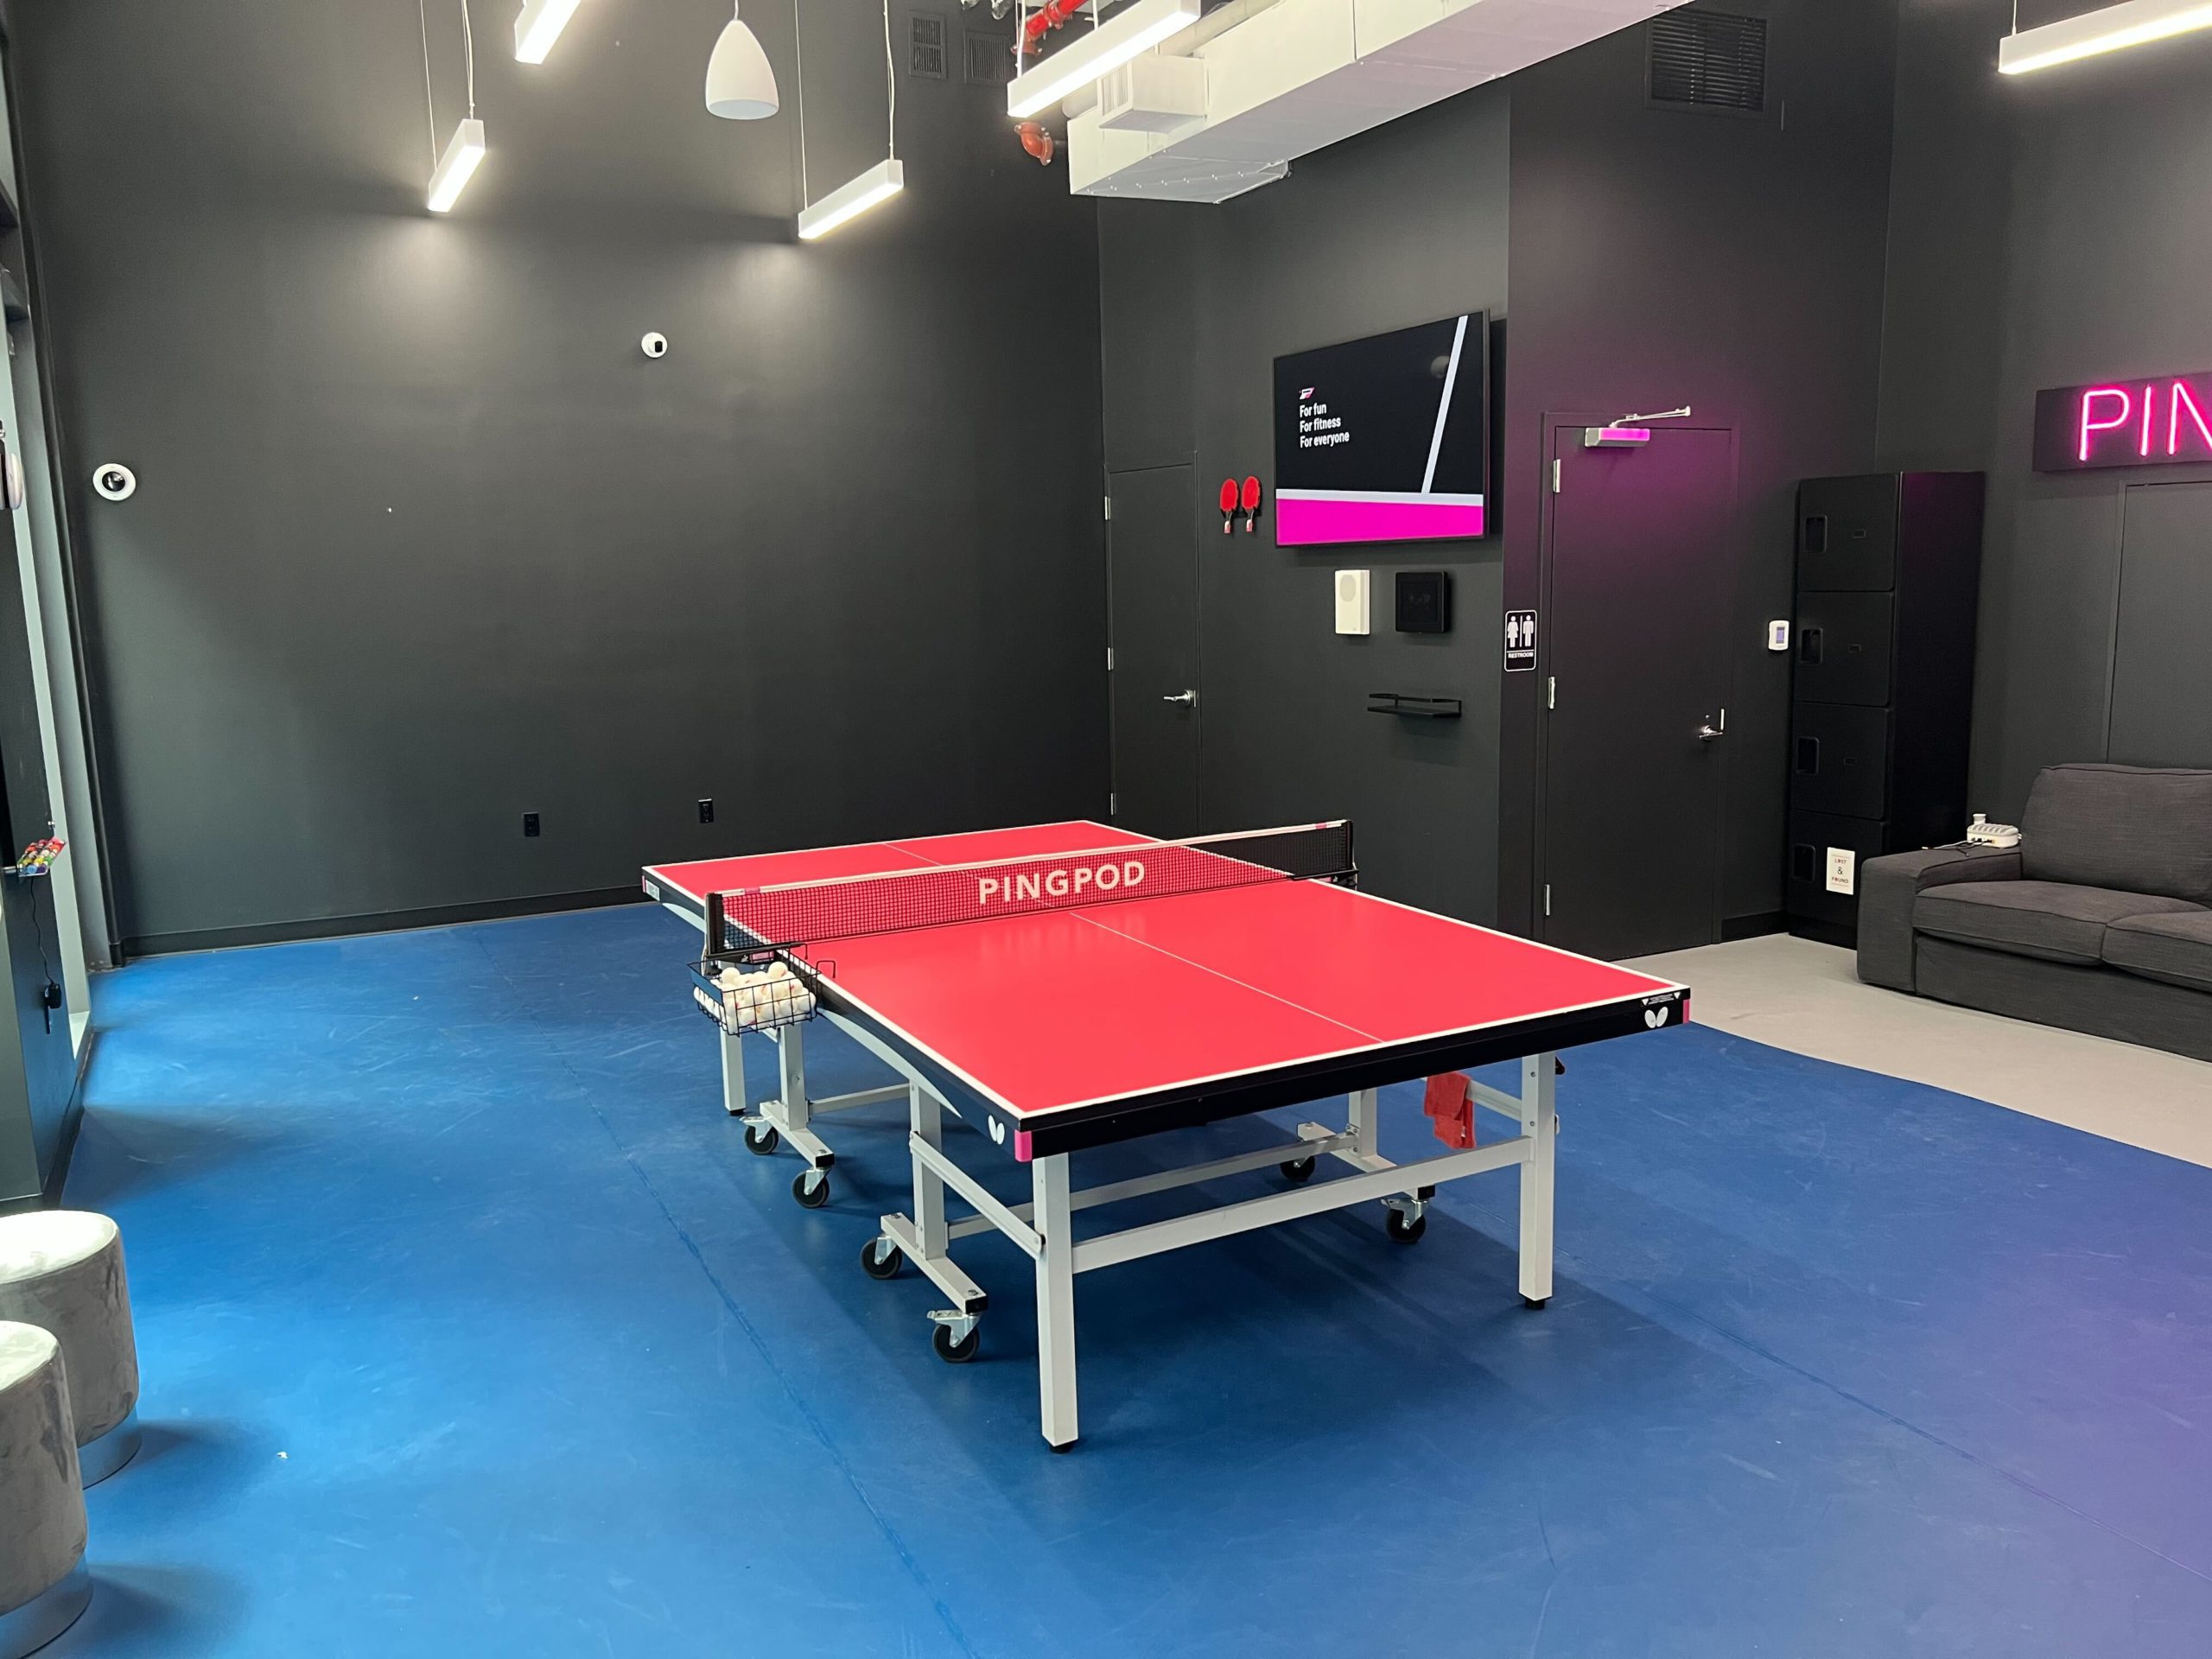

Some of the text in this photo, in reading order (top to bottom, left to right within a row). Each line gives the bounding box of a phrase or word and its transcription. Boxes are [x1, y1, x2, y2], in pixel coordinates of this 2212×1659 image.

[1300, 403, 1327, 417] For fun
[1300, 417, 1341, 433] For fitness
[1300, 432, 1350, 448] For everyone
[978, 861, 1145, 905] PINGPOD
